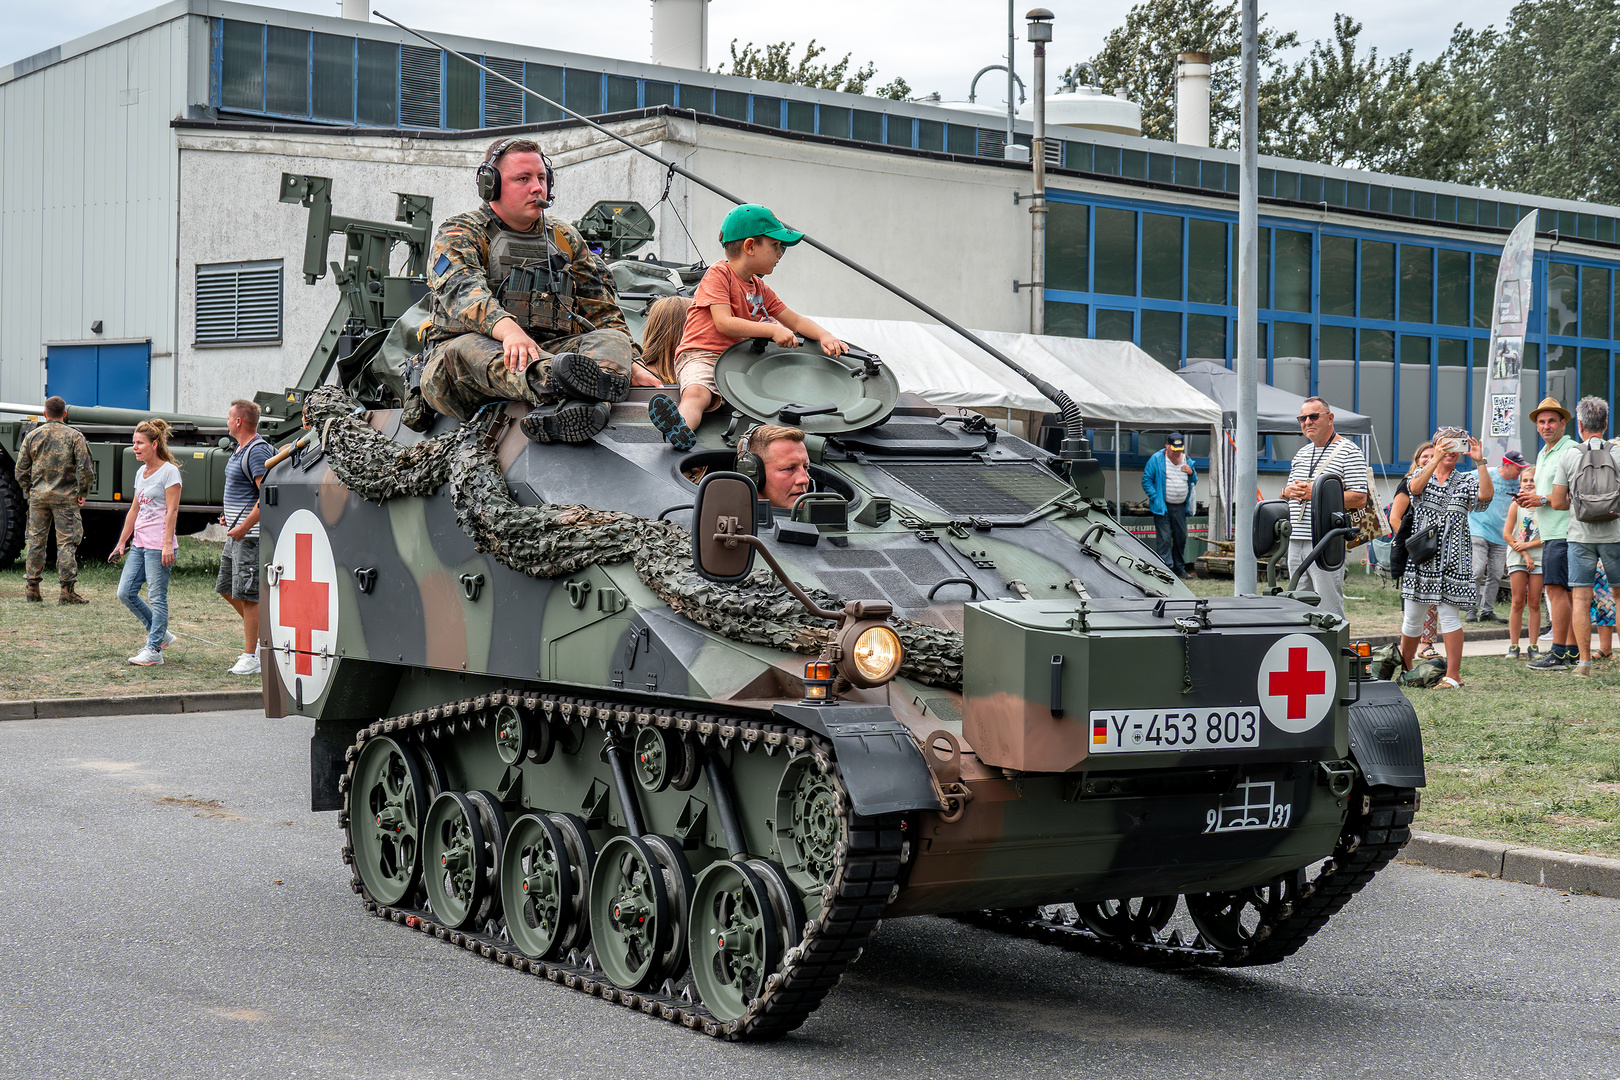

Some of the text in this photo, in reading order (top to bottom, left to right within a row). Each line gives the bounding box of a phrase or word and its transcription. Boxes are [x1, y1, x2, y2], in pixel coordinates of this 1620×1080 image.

[1349, 507, 1367, 523] ight
[1206, 710, 1256, 744] 803
[1204, 808, 1217, 833] 9
[1271, 803, 1291, 828] 31
